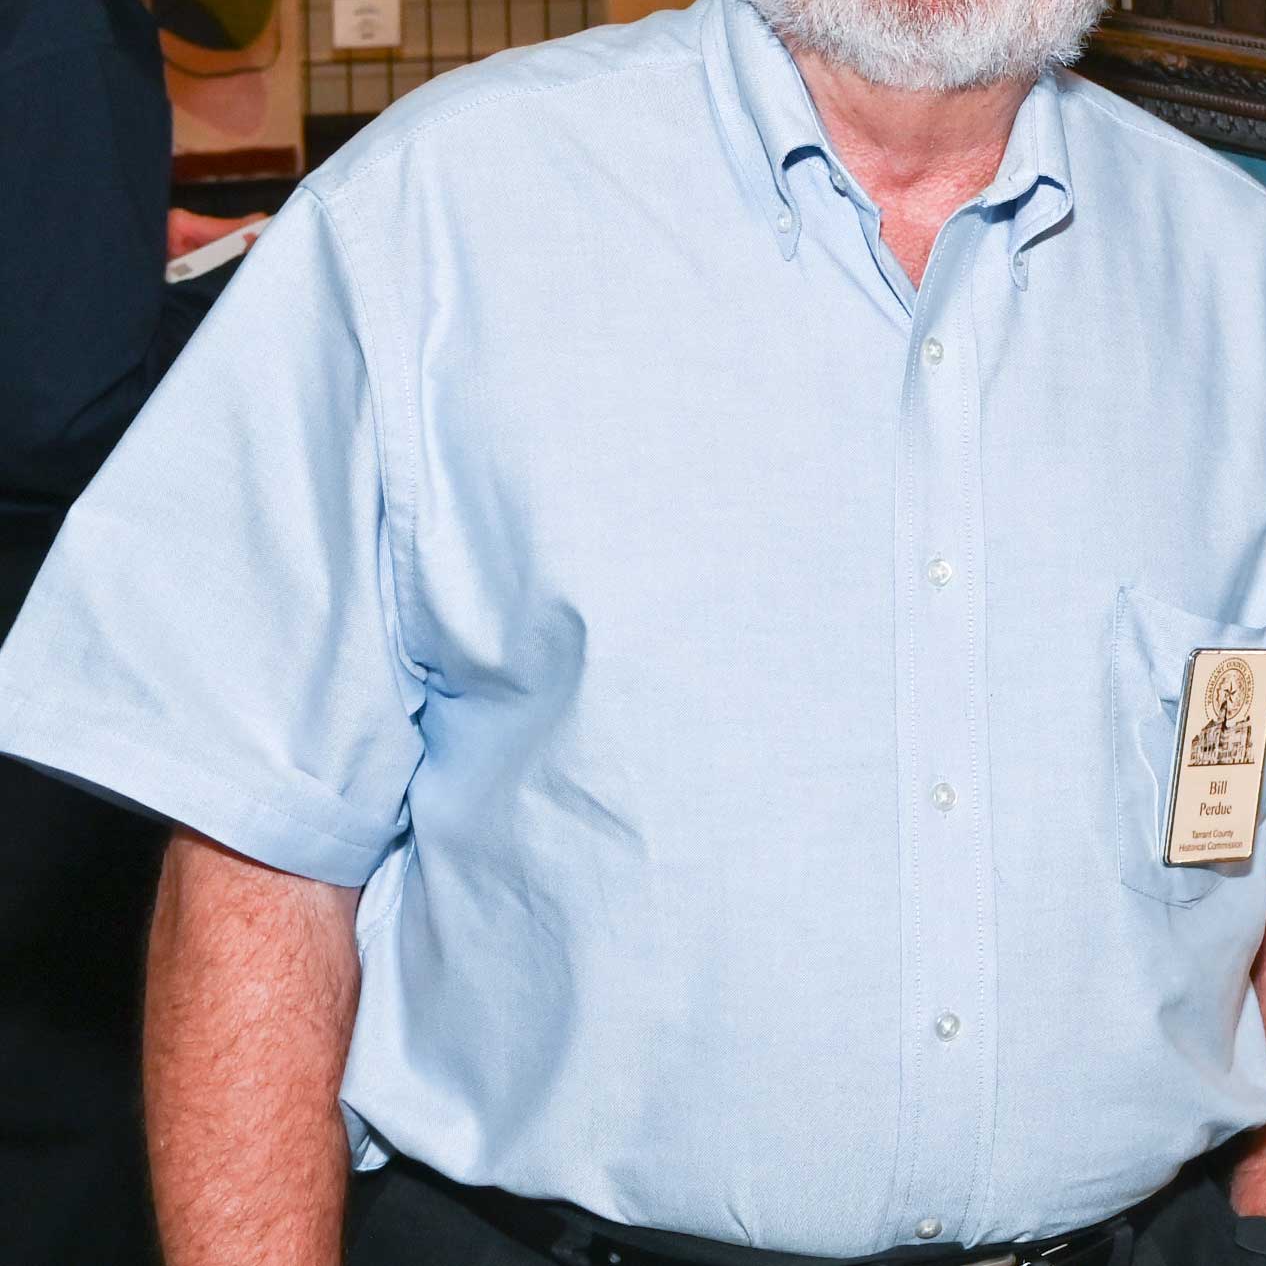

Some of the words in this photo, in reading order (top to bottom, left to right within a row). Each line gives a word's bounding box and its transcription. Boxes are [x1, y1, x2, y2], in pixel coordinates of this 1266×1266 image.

[1209, 781, 1228, 795] Bill
[1200, 802, 1232, 816] Perdue
[1192, 831, 1211, 839] Tarrant
[1213, 830, 1234, 838] County
